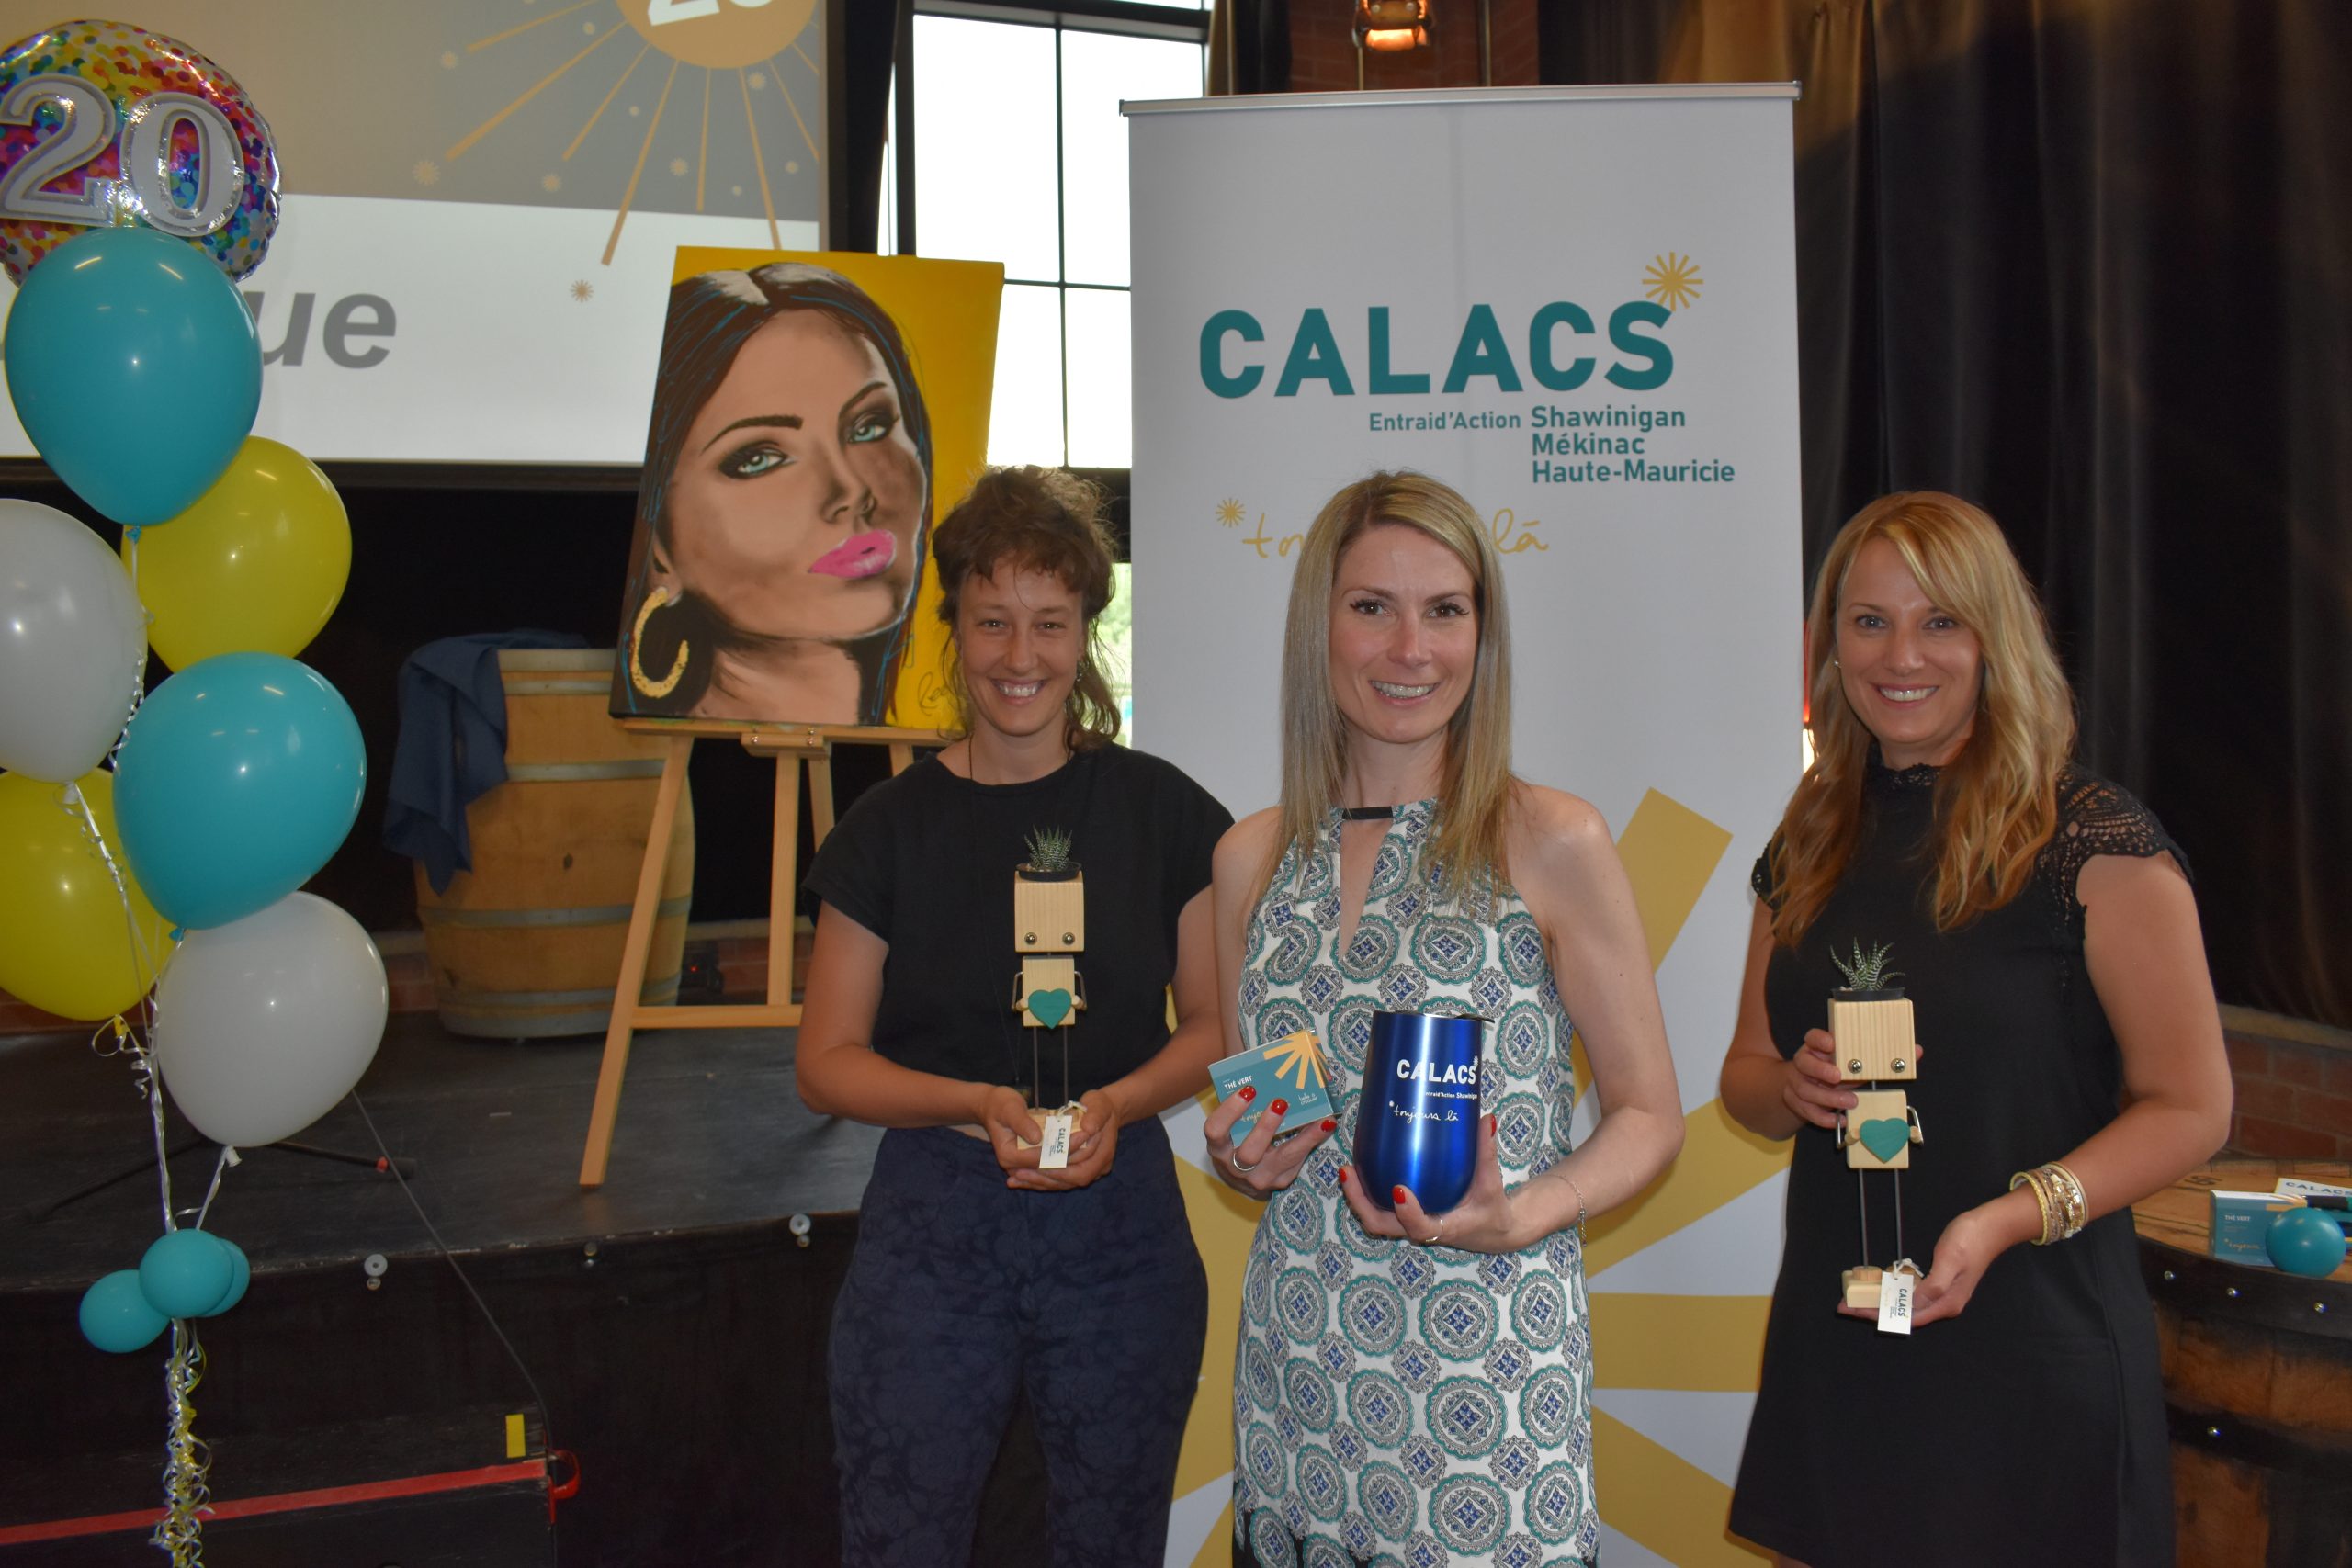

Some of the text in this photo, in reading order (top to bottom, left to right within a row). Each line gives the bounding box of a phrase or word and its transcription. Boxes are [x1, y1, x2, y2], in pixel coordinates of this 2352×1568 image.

[0, 73, 244, 237] 20
[1199, 301, 1675, 399] CALACS
[1370, 405, 1686, 433] Entraid'Action Shawinigan
[1532, 432, 1645, 456] Mékinac
[1532, 458, 1736, 484] Haute-Mauricie
[1237, 1075, 1253, 1086] VERT
[1396, 1058, 1476, 1085] CALACS
[1057, 1128, 1066, 1153] CALACS
[1898, 1288, 1907, 1316] CALACS
